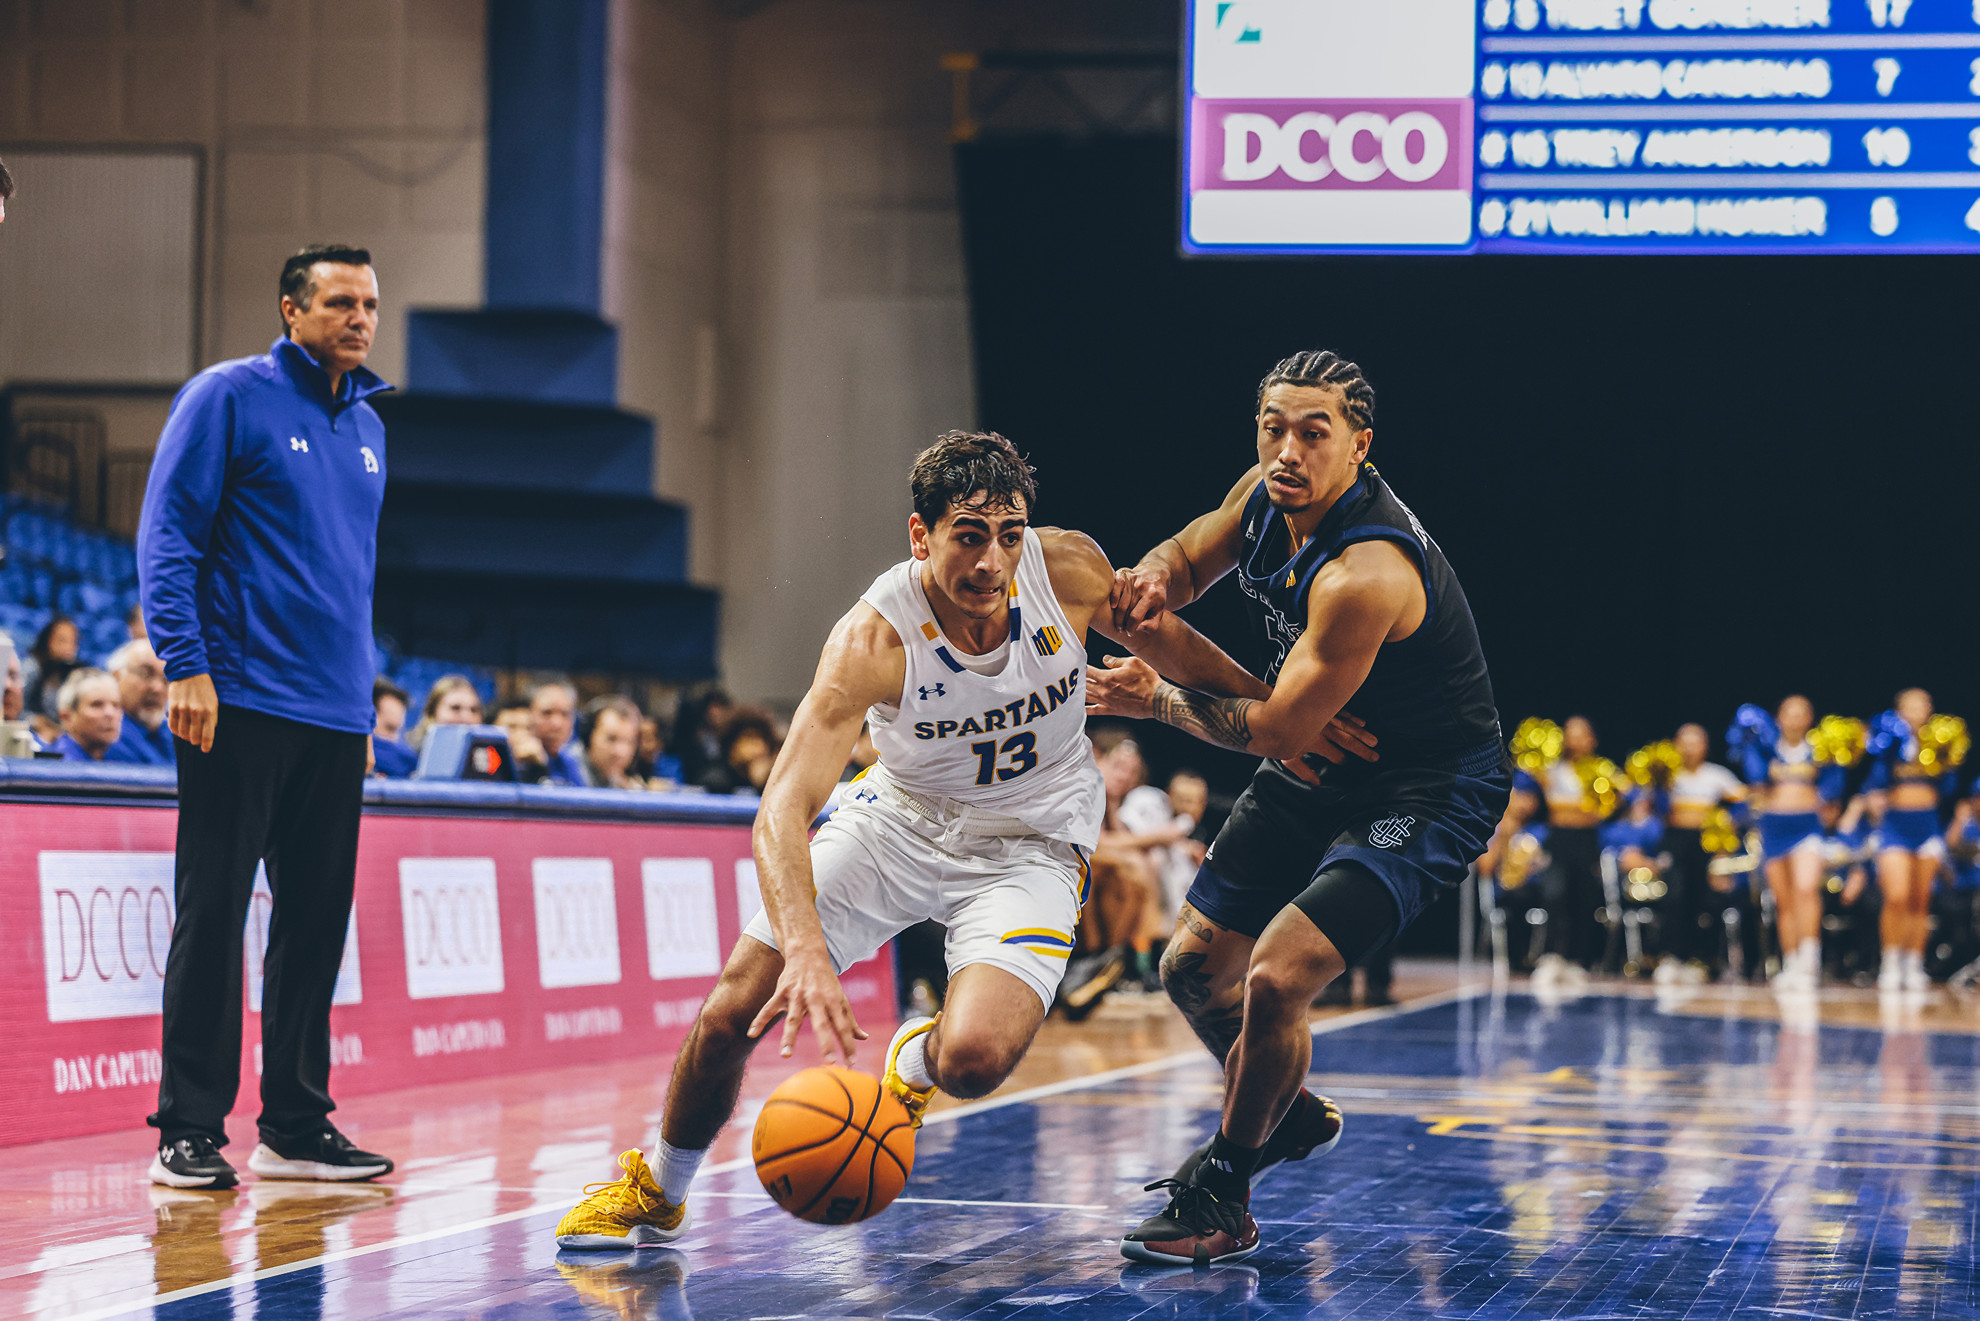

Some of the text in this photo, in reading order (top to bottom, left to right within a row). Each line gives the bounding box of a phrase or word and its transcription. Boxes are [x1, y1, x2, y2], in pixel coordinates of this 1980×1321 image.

[1221, 111, 1448, 182] DCCO
[914, 668, 1079, 740] SPARTANS
[971, 730, 1039, 785] 13
[54, 1056, 92, 1094] DAN
